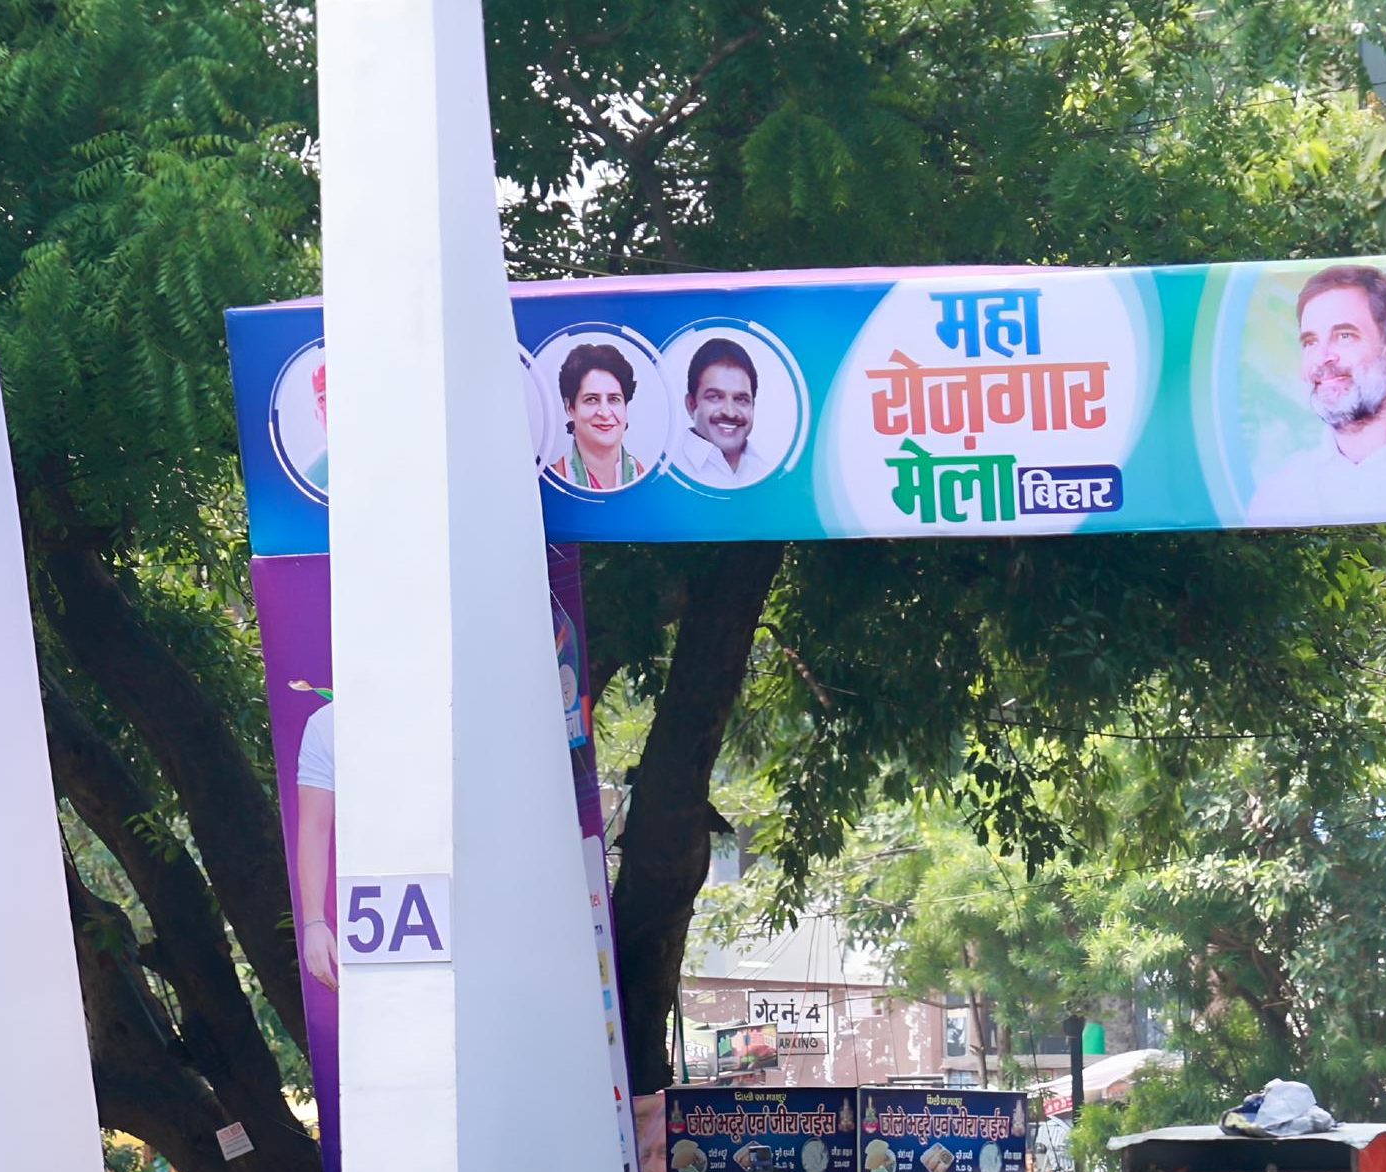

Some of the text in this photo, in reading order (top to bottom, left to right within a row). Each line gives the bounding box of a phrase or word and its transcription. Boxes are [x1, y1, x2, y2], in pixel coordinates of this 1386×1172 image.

[929, 288, 1043, 358] महा
[865, 349, 1110, 450] रोज़गार
[884, 437, 1113, 524] मेला बिहार
[347, 884, 444, 953] 5A
[753, 998, 779, 1024] गेट
[804, 1002, 822, 1024] 4
[778, 1037, 819, 1050] ARKING
[686, 1106, 715, 1136] छोले
[747, 1105, 769, 1136] एवं
[770, 1103, 799, 1136] जीरा
[800, 1103, 836, 1137] राईस
[878, 1105, 906, 1137] छोले
[932, 1107, 951, 1138] एवं
[951, 1105, 979, 1138] जीरा
